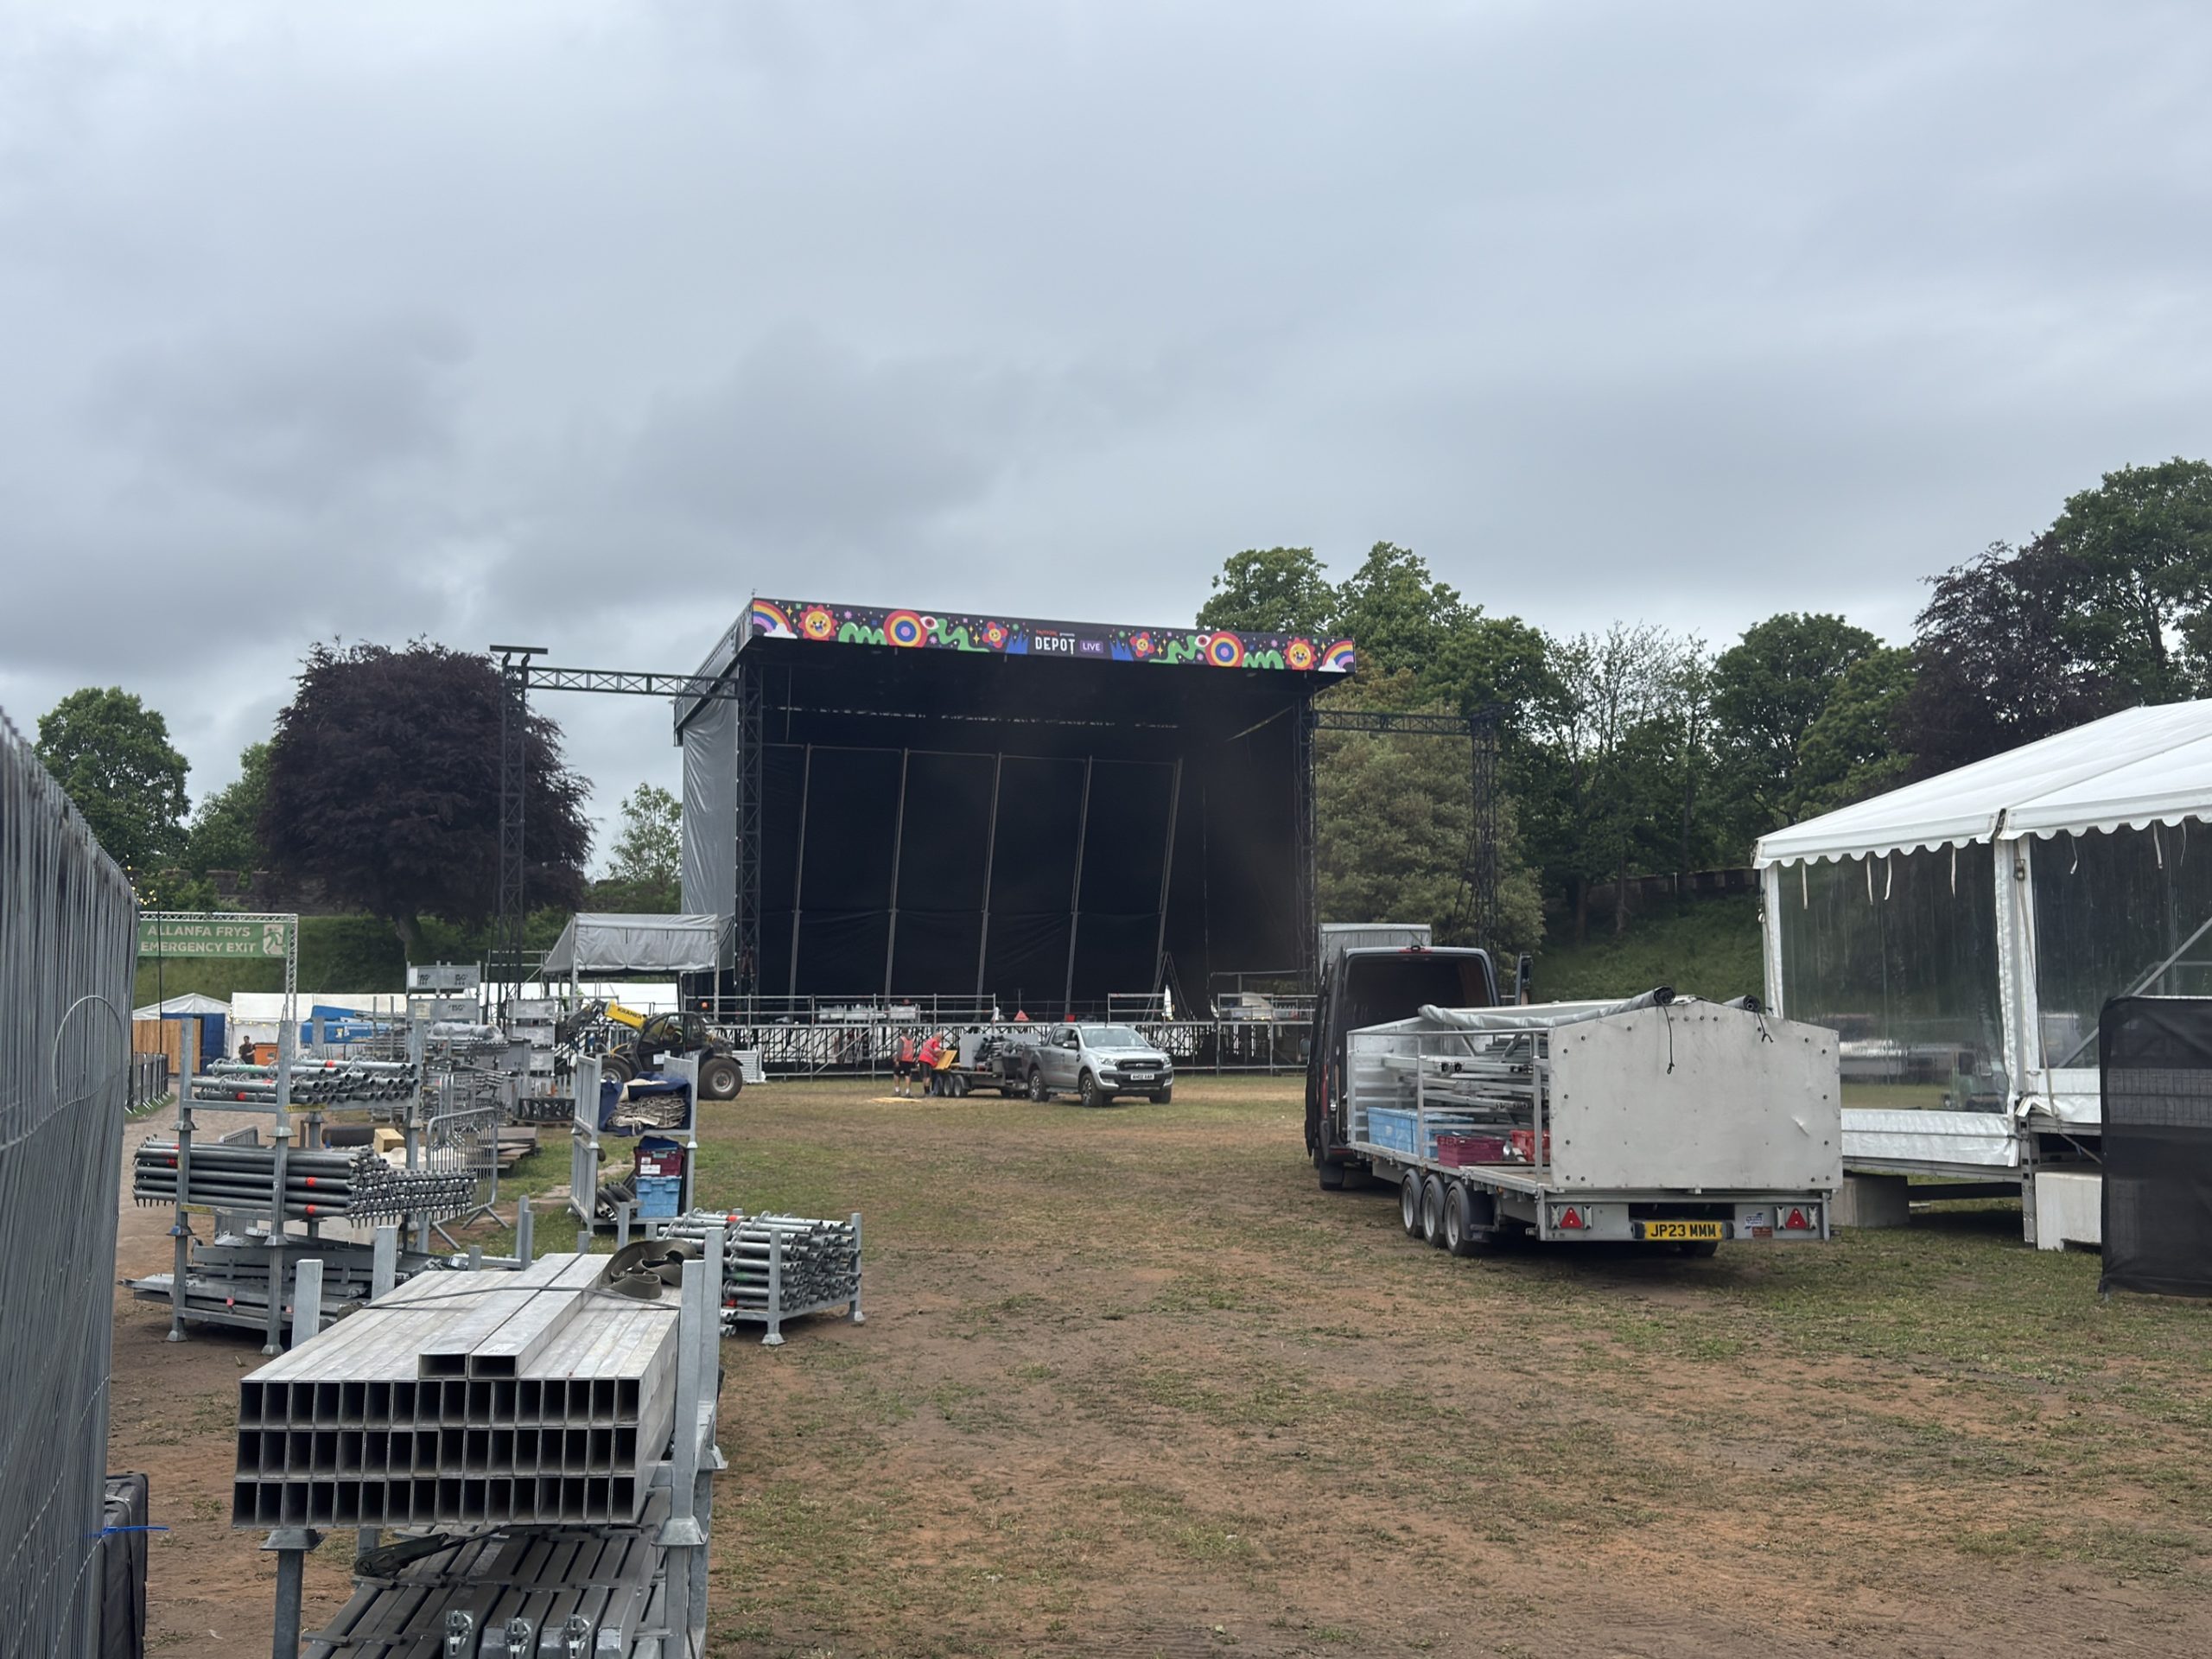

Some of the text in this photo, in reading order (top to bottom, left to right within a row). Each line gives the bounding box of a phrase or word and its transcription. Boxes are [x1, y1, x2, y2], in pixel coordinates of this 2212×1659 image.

[1035, 637, 1101, 655] DEPOT LIVE
[148, 925, 251, 938] ALLANFA FRYS
[141, 941, 257, 953] EMERGENCY EXIT
[1650, 1224, 1717, 1237] JP23 MMM
